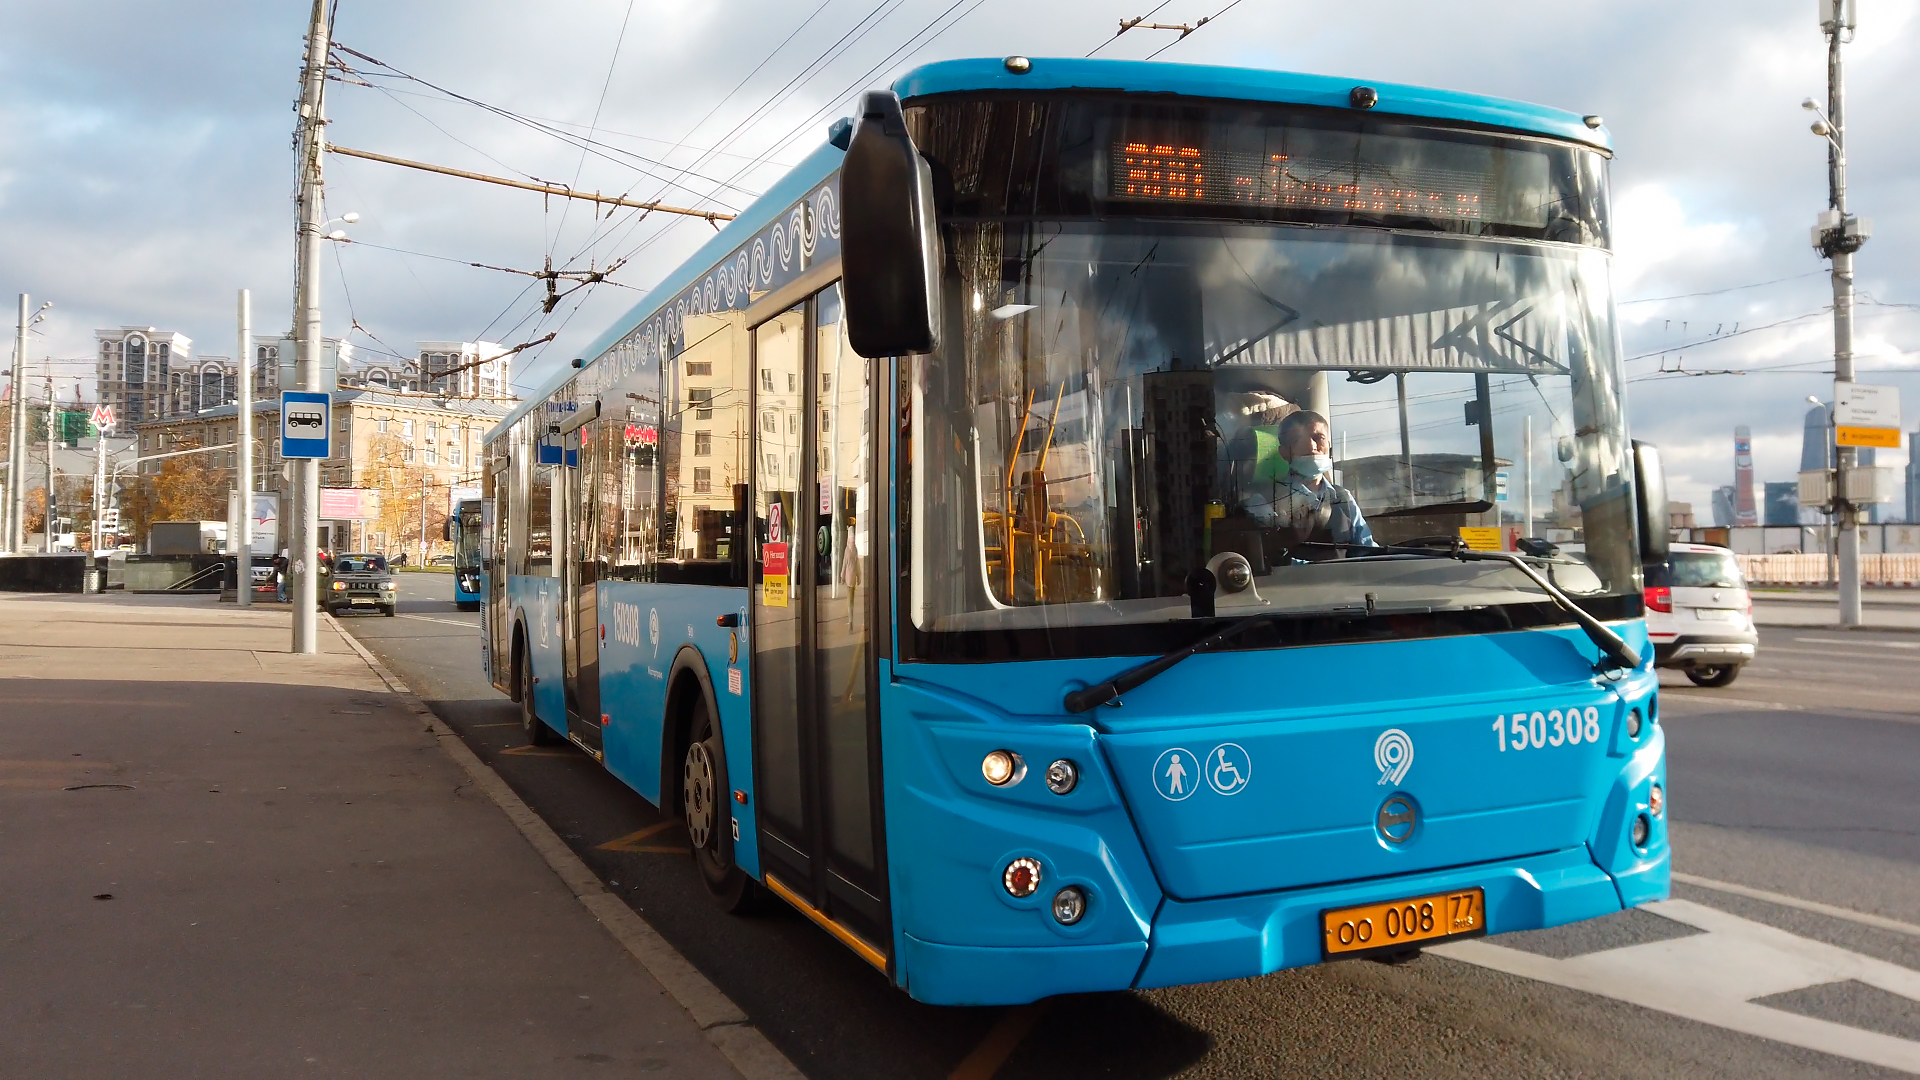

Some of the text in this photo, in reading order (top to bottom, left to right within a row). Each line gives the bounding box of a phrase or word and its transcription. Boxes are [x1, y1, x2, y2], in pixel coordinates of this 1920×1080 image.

[612, 601, 640, 648] 150308
[1492, 706, 1600, 752] 150308
[1386, 901, 1435, 938] 008
[1450, 894, 1474, 919] 77
[1453, 916, 1474, 929] RUS
